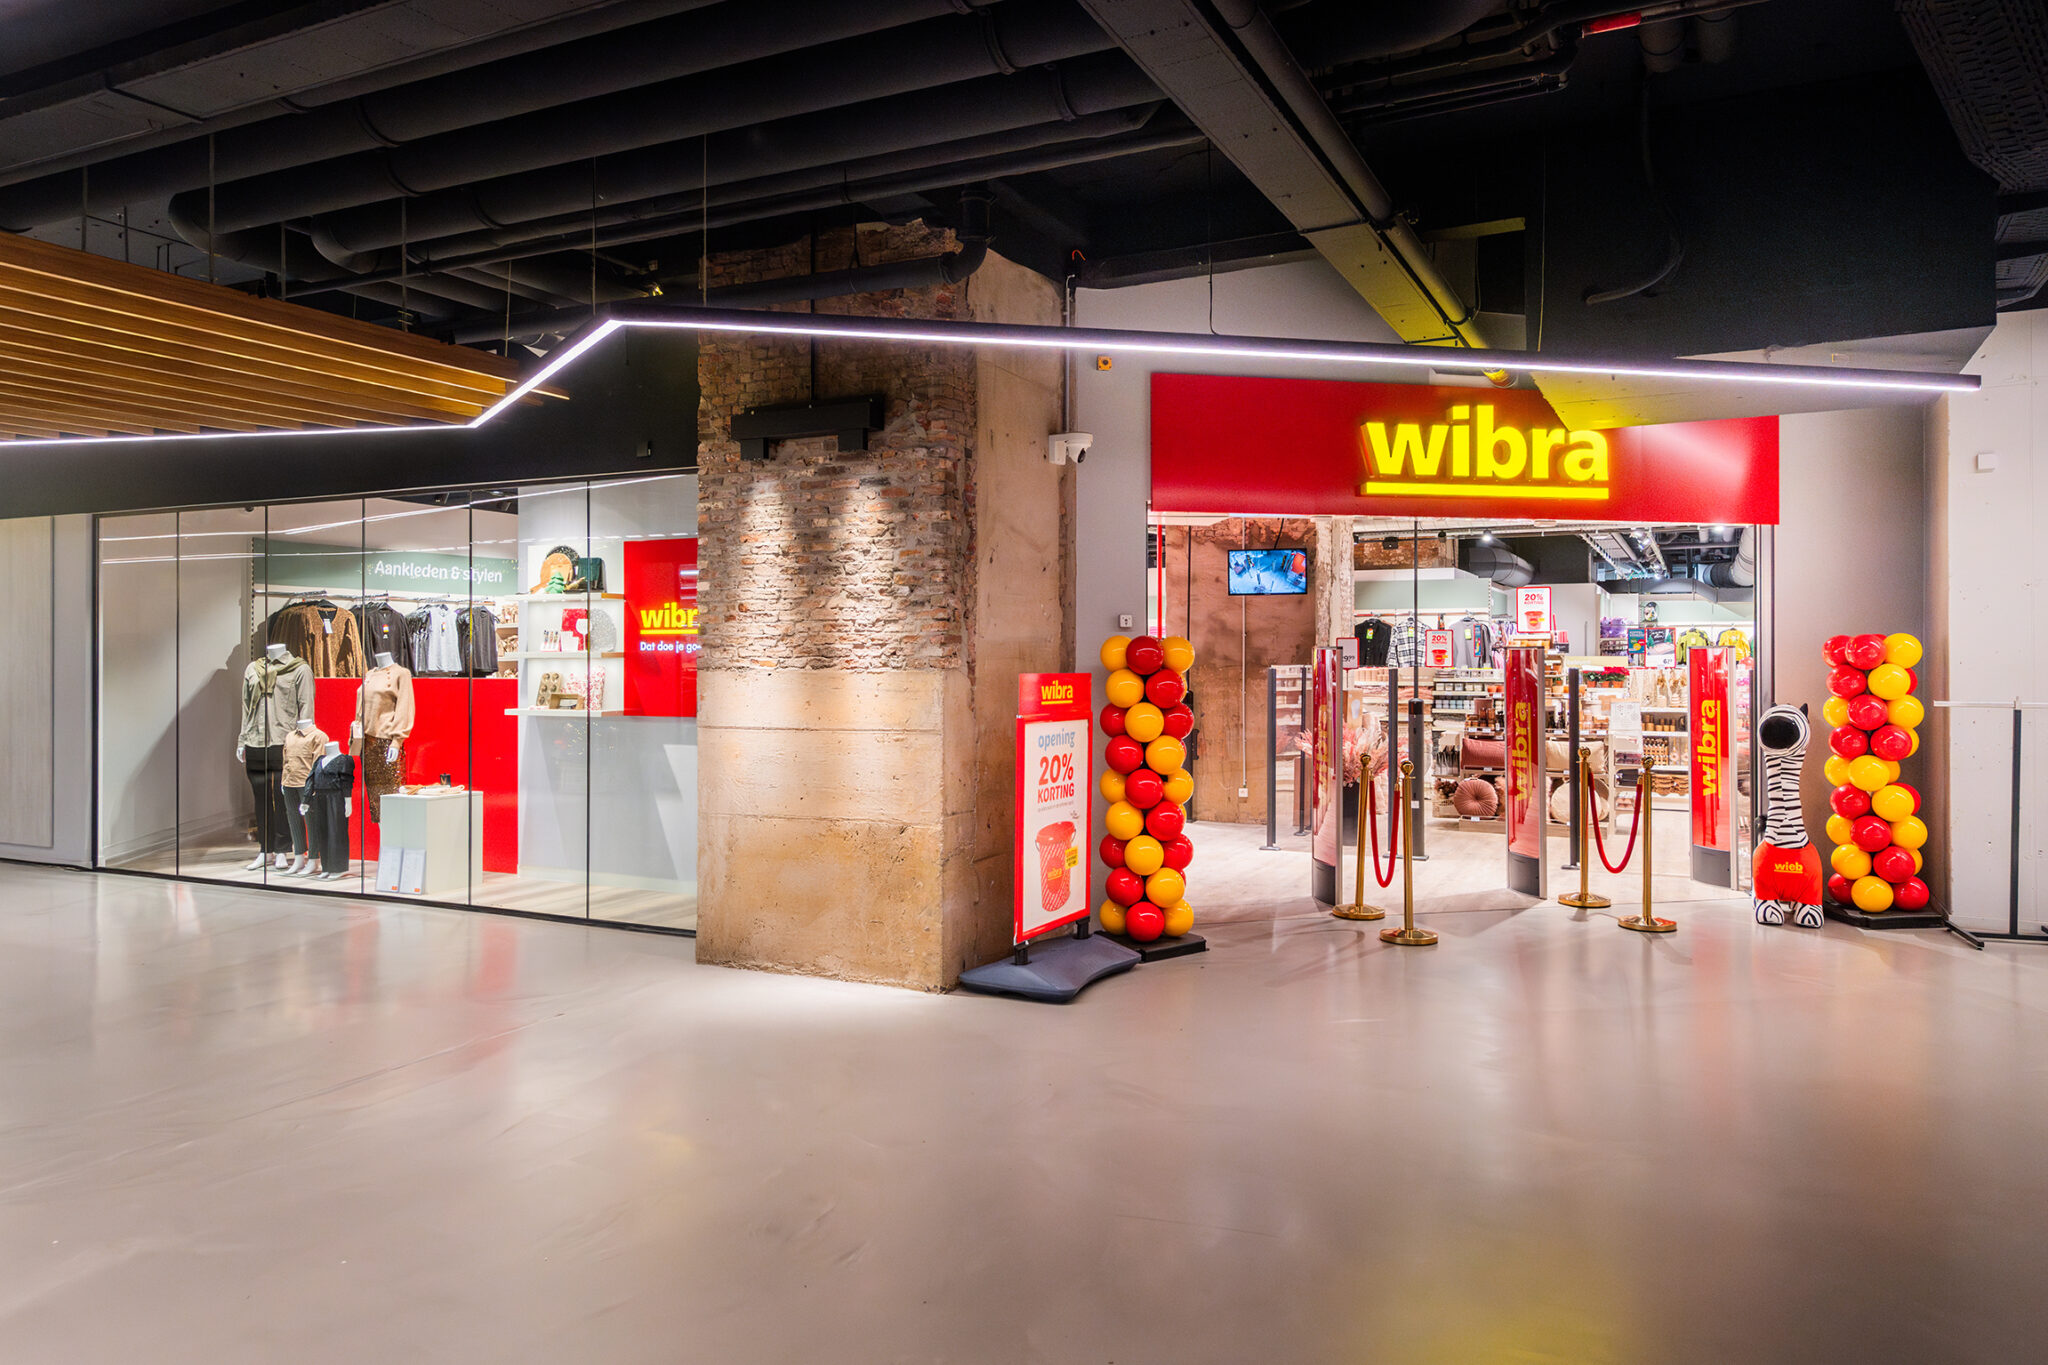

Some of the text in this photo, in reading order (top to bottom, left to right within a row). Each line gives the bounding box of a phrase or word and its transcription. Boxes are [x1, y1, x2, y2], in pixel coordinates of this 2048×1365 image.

[1361, 404, 1609, 482] wibra
[374, 560, 502, 585] Aankleden & stylen
[1524, 593, 1544, 601] 20%
[640, 602, 699, 628] wibr
[640, 640, 698, 654] Dat doe je go
[1041, 680, 1073, 700] wibra
[1038, 728, 1075, 751] opening
[1511, 702, 1528, 801] wibra
[1697, 699, 1717, 797] wibra
[1038, 752, 1074, 786] 20%
[1037, 782, 1075, 804] KORTING
[1774, 861, 1804, 872] wieb
